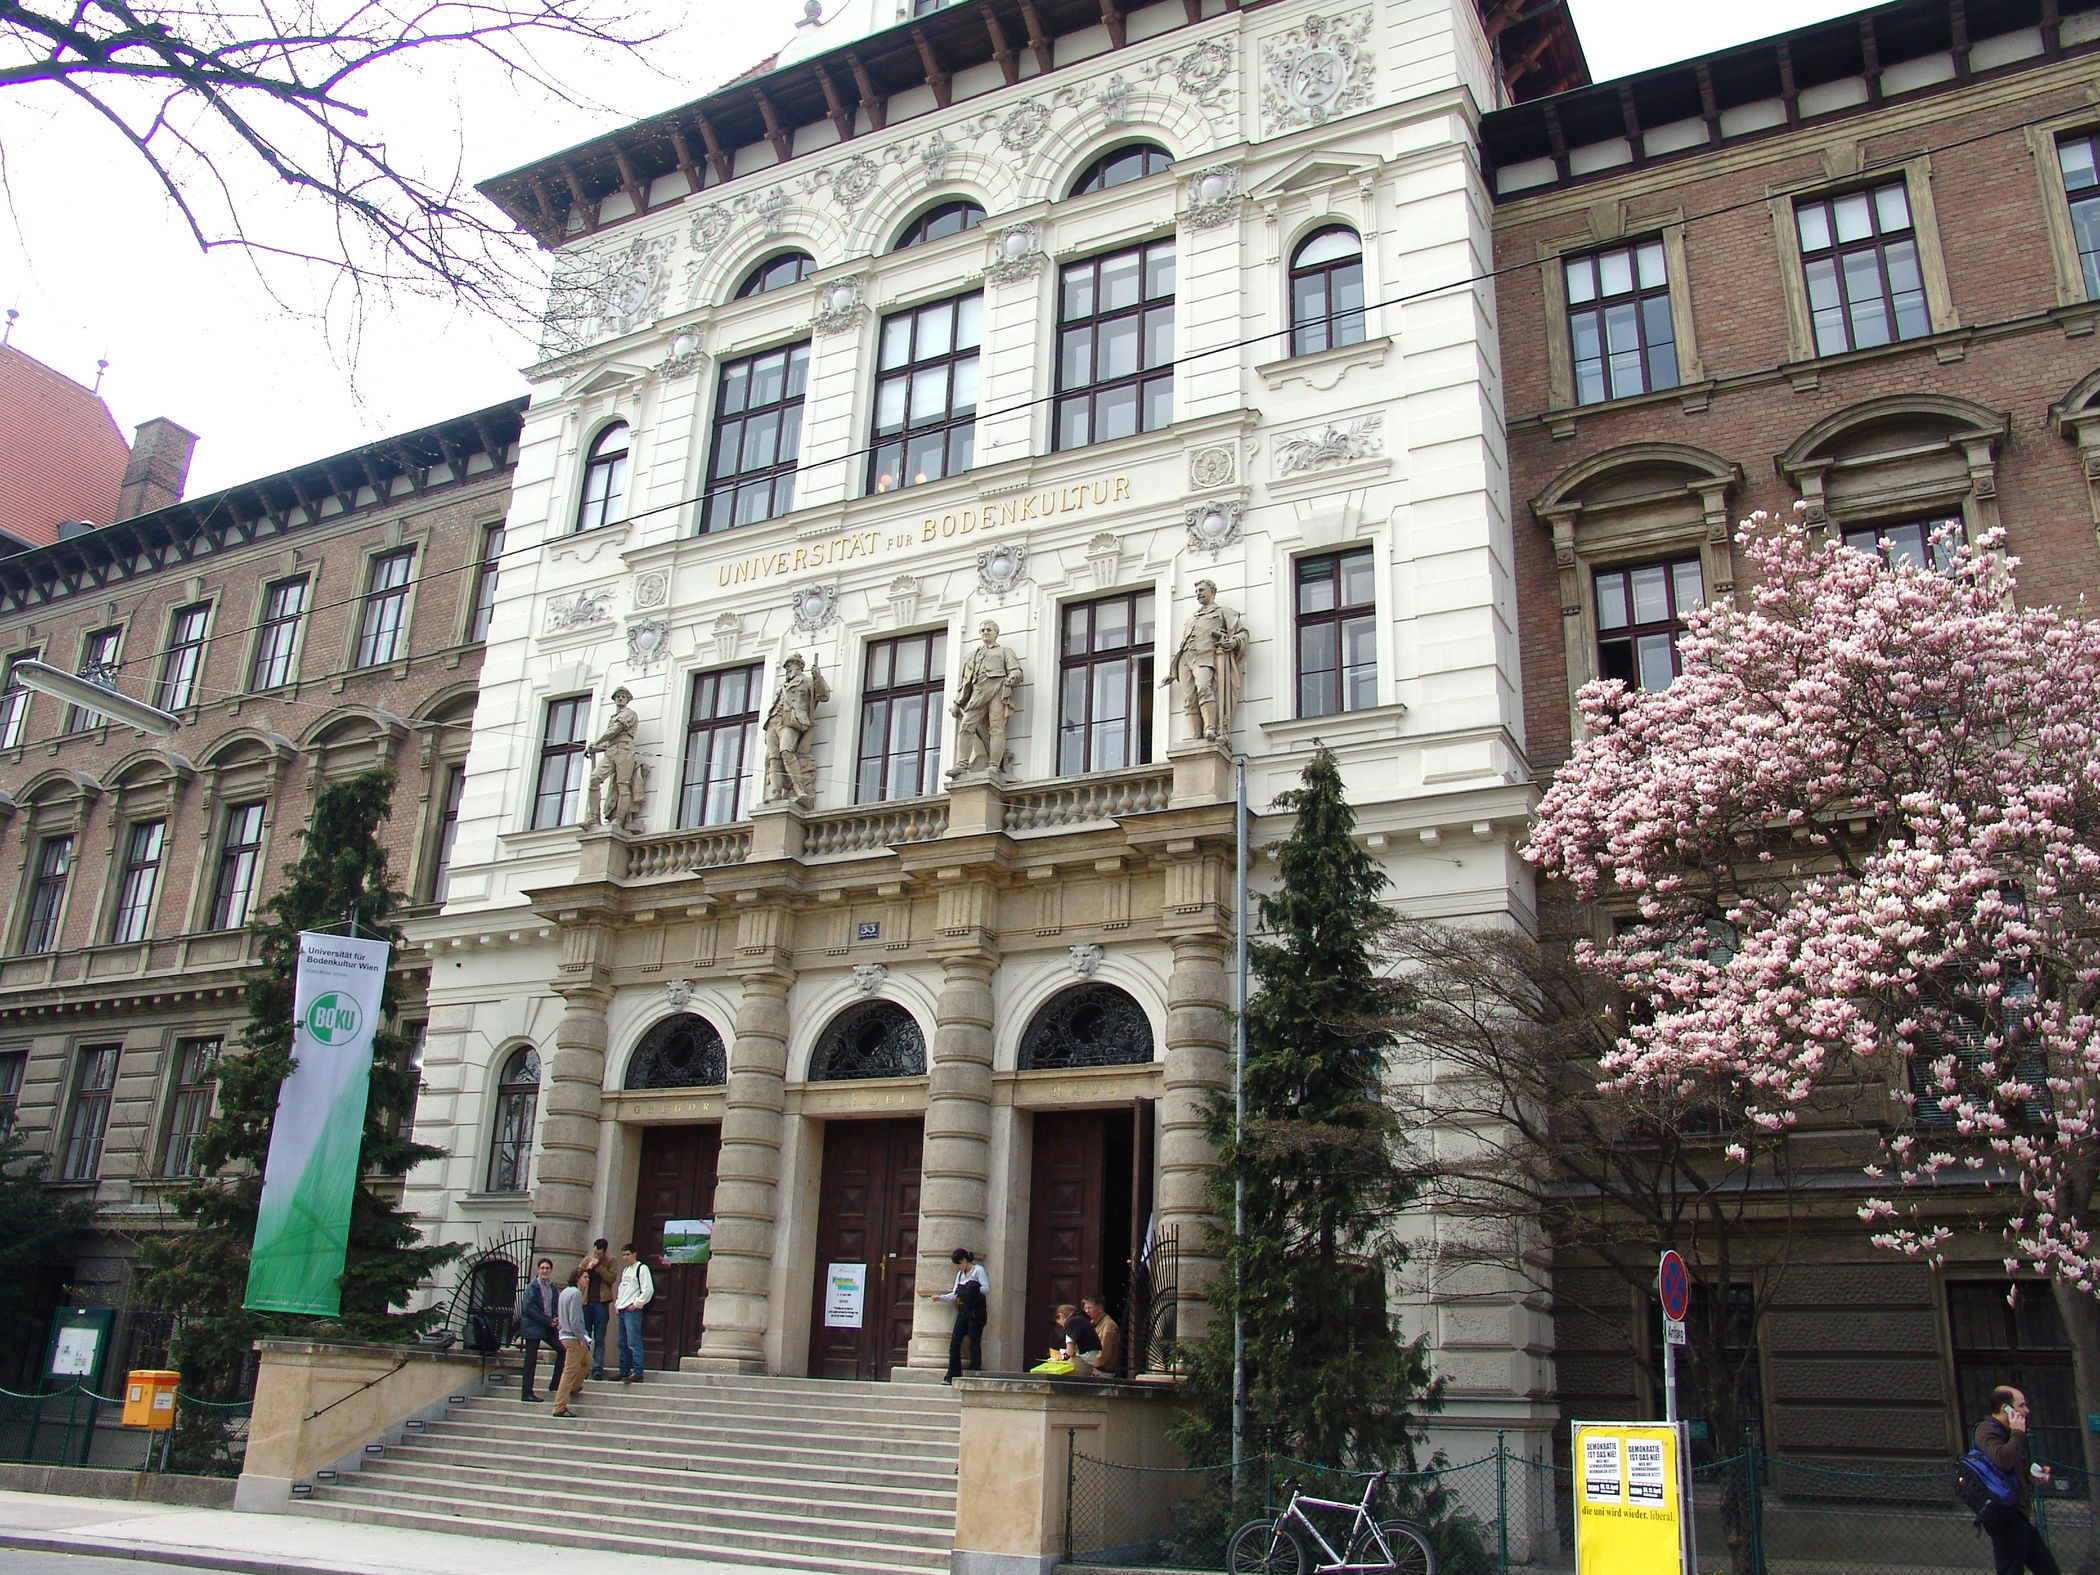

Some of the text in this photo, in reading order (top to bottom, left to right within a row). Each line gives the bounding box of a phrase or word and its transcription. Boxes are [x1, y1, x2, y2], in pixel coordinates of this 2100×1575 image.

[717, 475, 1131, 587] UNIVERSITÄT FÜR BODENKULTUR
[309, 947, 366, 961] Universität für
[307, 956, 379, 972] Bodenkultur Wien
[314, 1006, 356, 1031] BOKU
[1628, 1445, 1660, 1453] DEMOKRATIE
[1582, 1506, 1676, 1522] die uni wird wieder. liberal.
